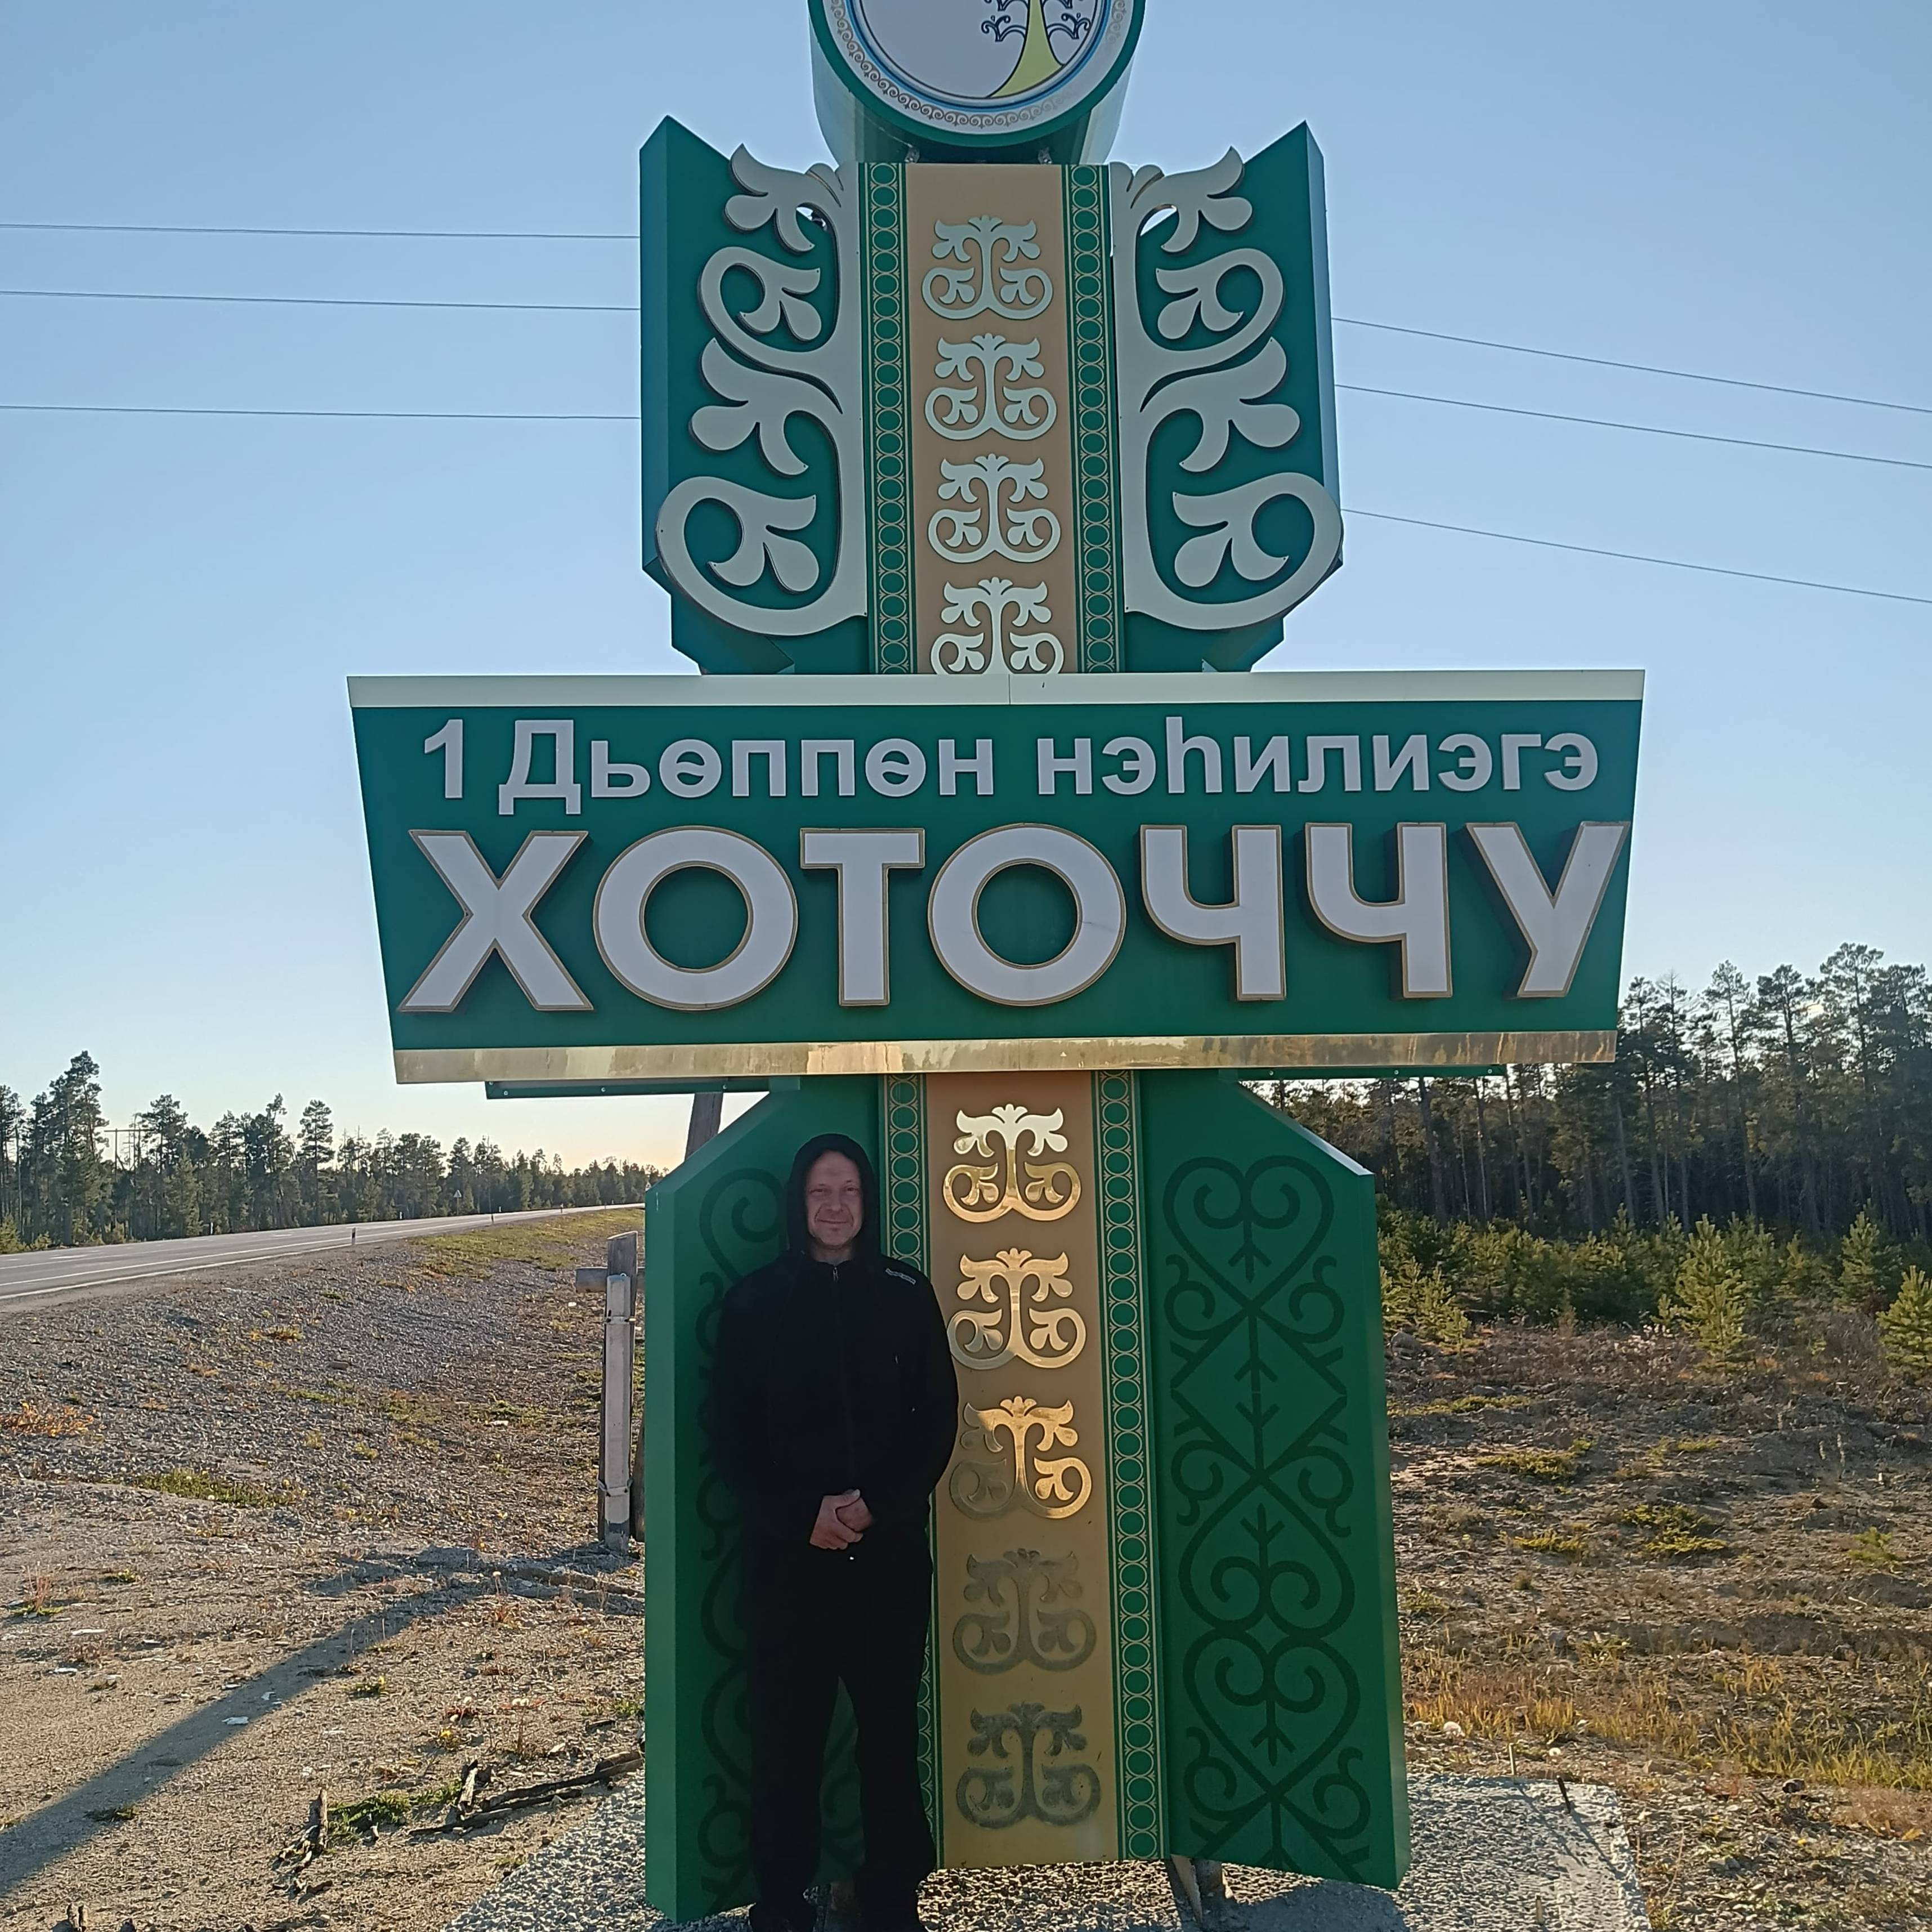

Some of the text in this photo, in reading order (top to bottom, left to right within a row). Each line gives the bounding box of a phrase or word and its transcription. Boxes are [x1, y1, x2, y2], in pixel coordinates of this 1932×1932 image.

[424, 715, 1599, 816] 1 Дьөппөн нэһилиэгэ
[396, 820, 1631, 1012] ХОТОЧЧУ
